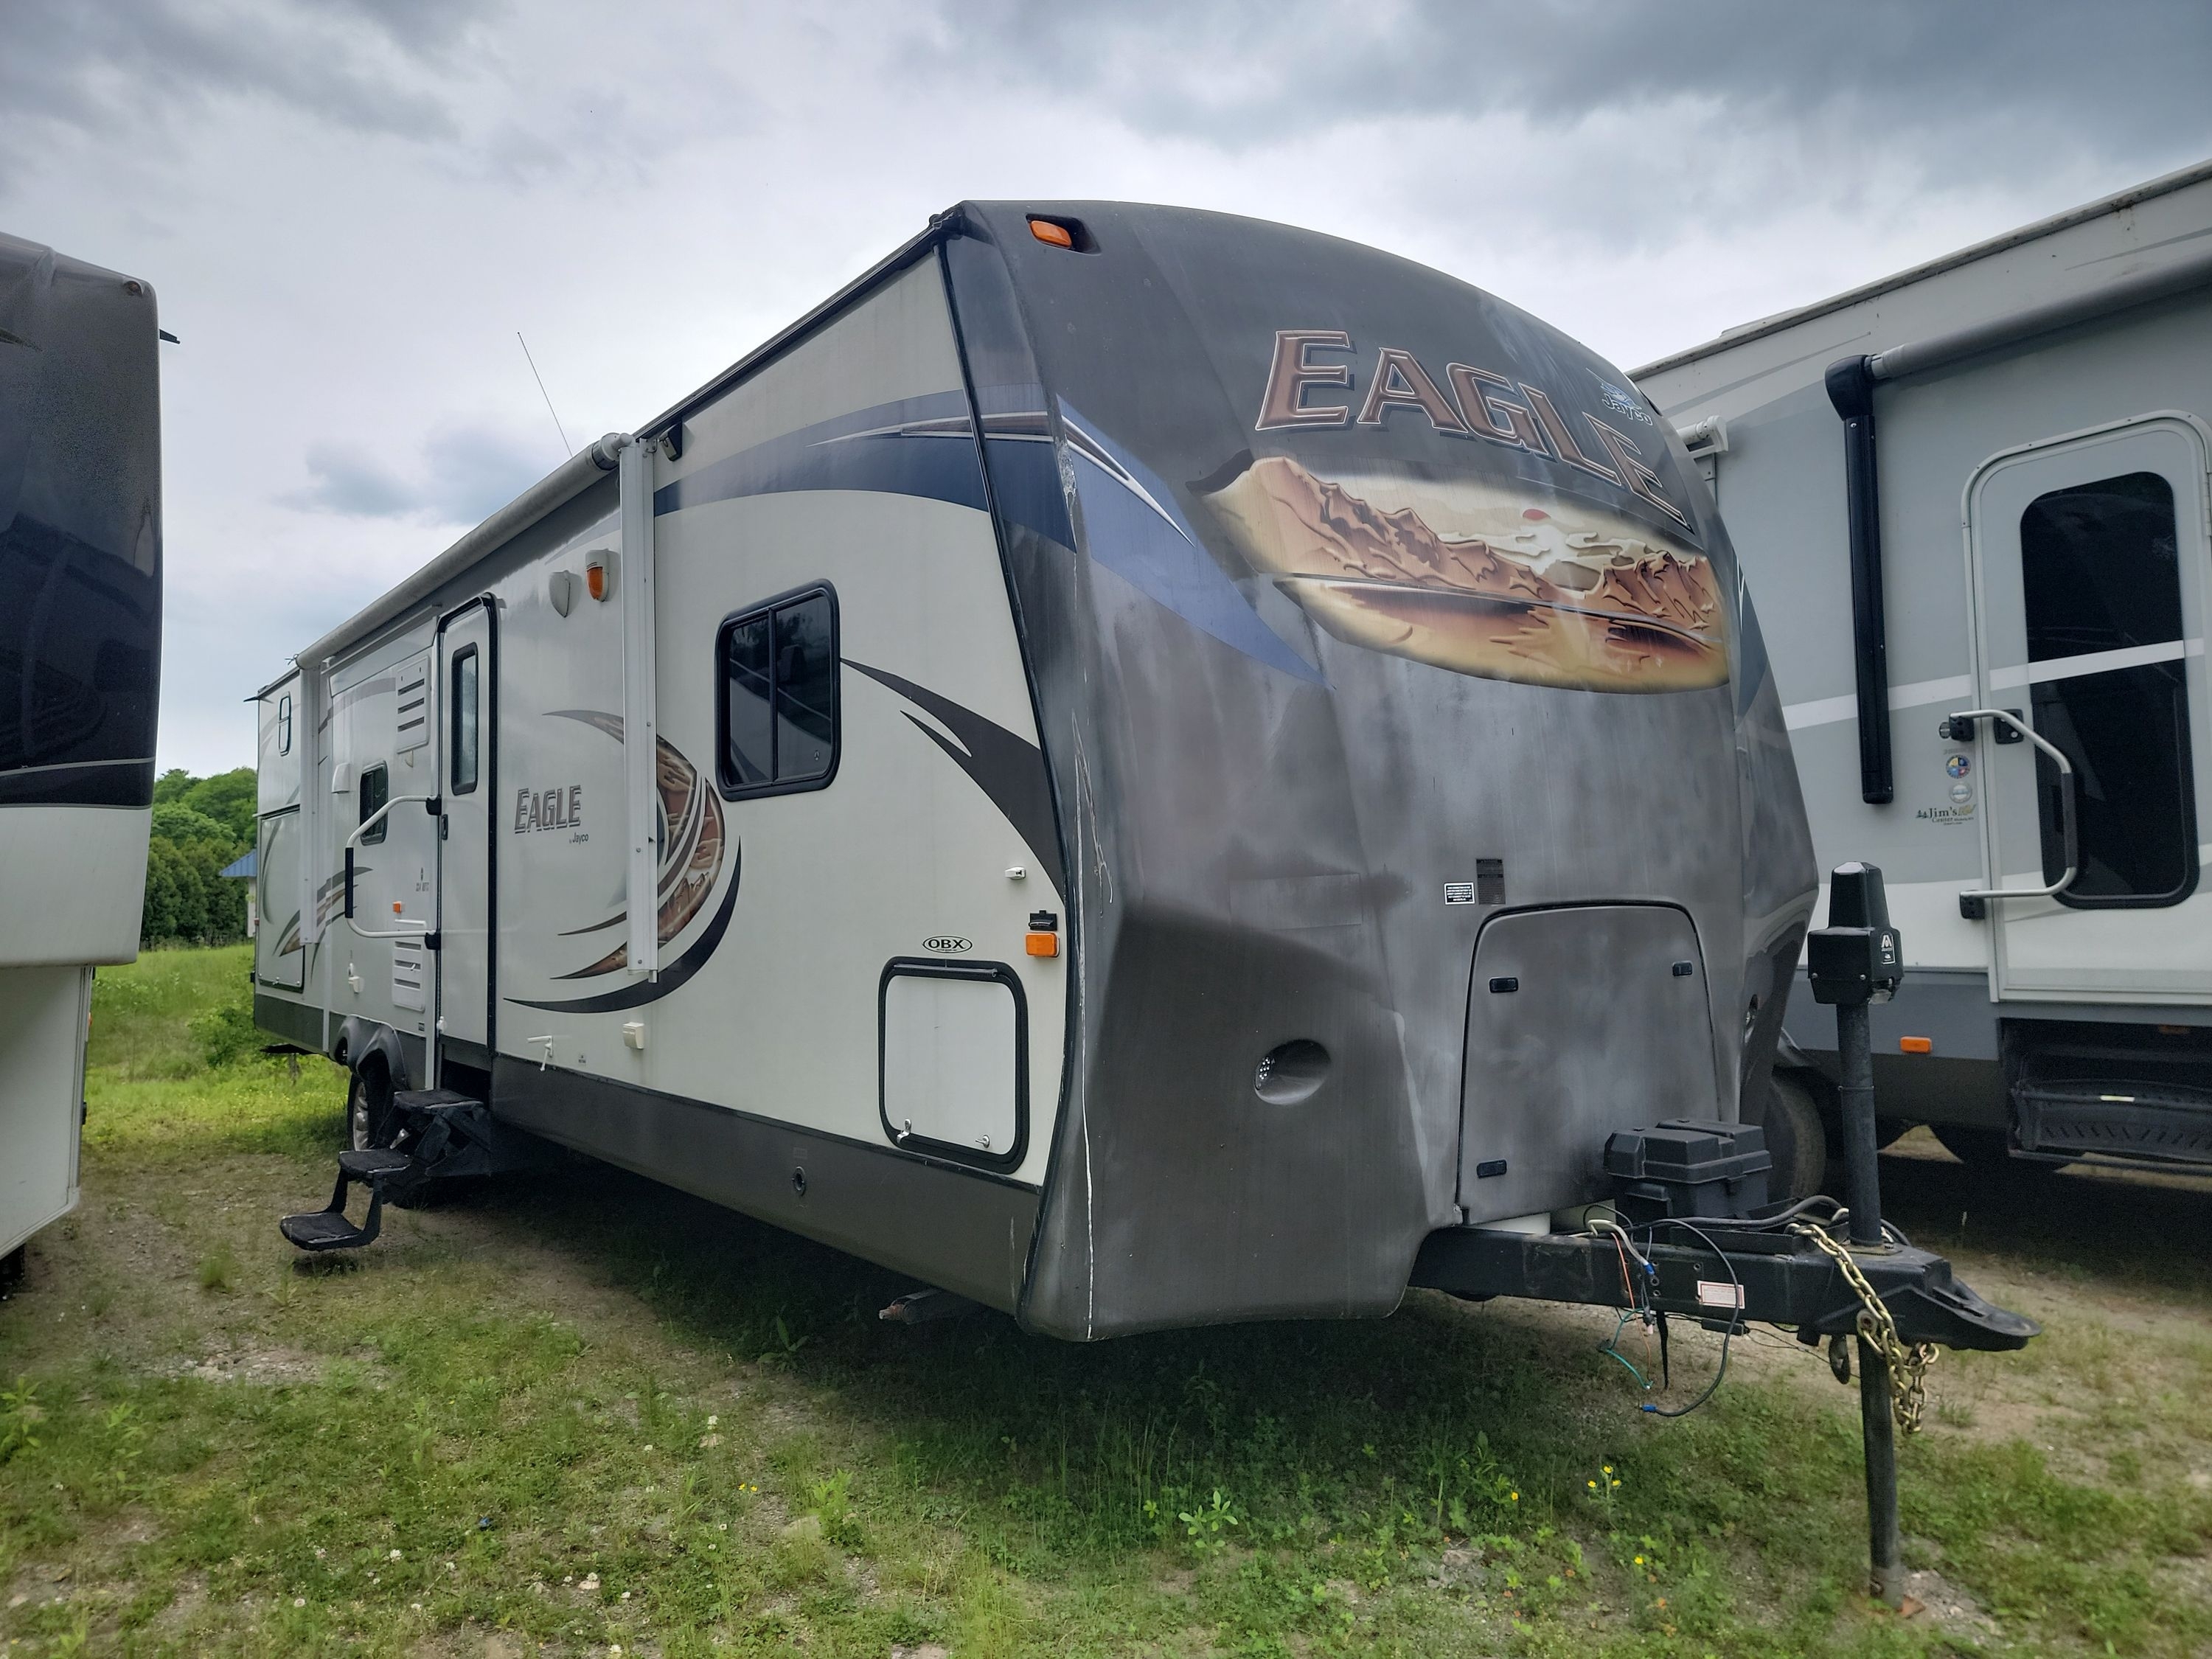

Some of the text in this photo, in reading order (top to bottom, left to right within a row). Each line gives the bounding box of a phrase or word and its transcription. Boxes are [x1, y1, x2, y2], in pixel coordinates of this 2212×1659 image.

[1601, 392, 1653, 426] Jayco
[1255, 330, 1693, 533] EAGLE
[514, 785, 582, 834] EAGLE
[1930, 807, 1958, 818] Jim's
[572, 832, 589, 845] Jayco
[928, 939, 966, 949] OBX
